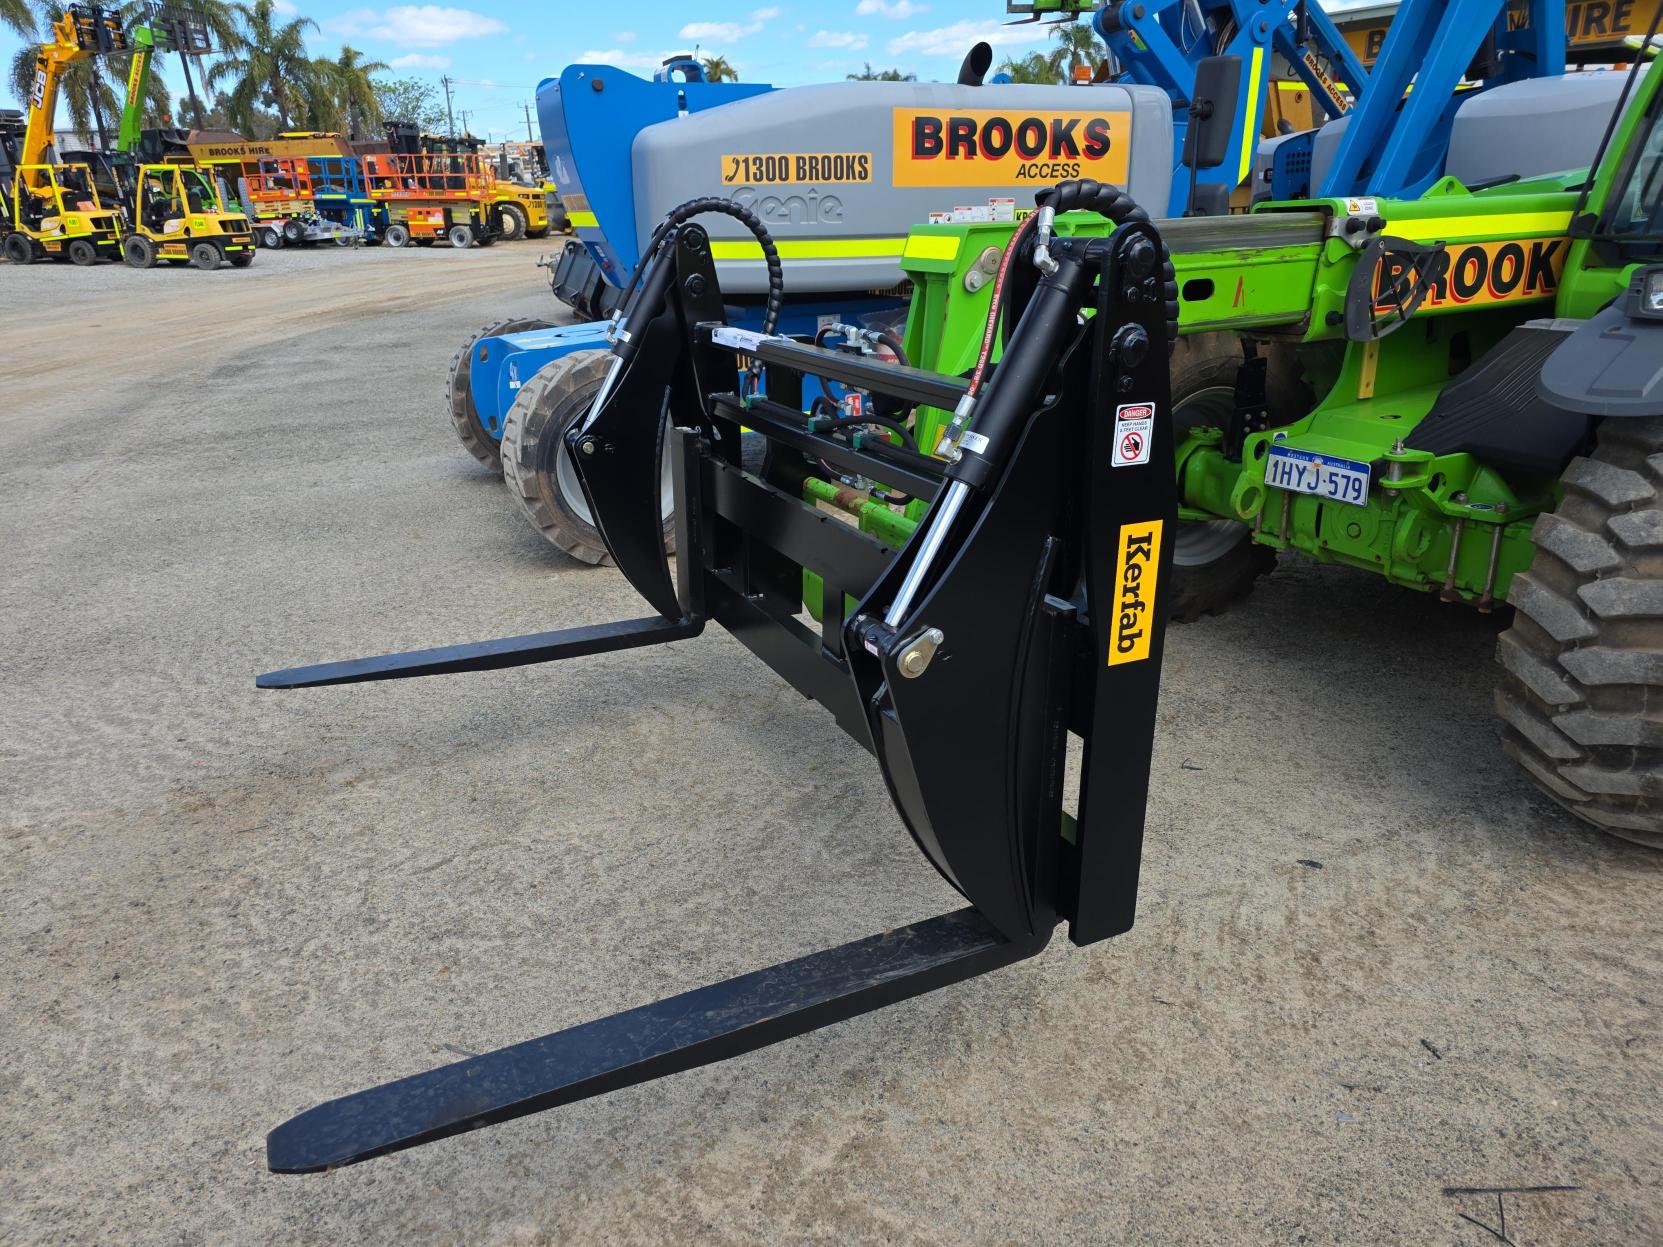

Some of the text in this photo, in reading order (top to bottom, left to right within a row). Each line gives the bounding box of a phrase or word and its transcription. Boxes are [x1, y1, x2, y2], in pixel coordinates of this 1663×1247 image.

[1567, 0, 1631, 37] IRE
[33, 70, 47, 110] JCB
[1305, 54, 1347, 111] BROOKS ACCESS
[208, 147, 246, 156] BROOKS
[911, 116, 1111, 161] BROOKS
[742, 155, 869, 182] 1300 BROOKS
[1016, 163, 1080, 179] ACCESS
[1374, 240, 1569, 312] BROOK
[1124, 410, 1147, 418] DANGER
[1287, 452, 1351, 470] WESTERN AUSTRALIA
[1117, 532, 1152, 653] Kerfab
